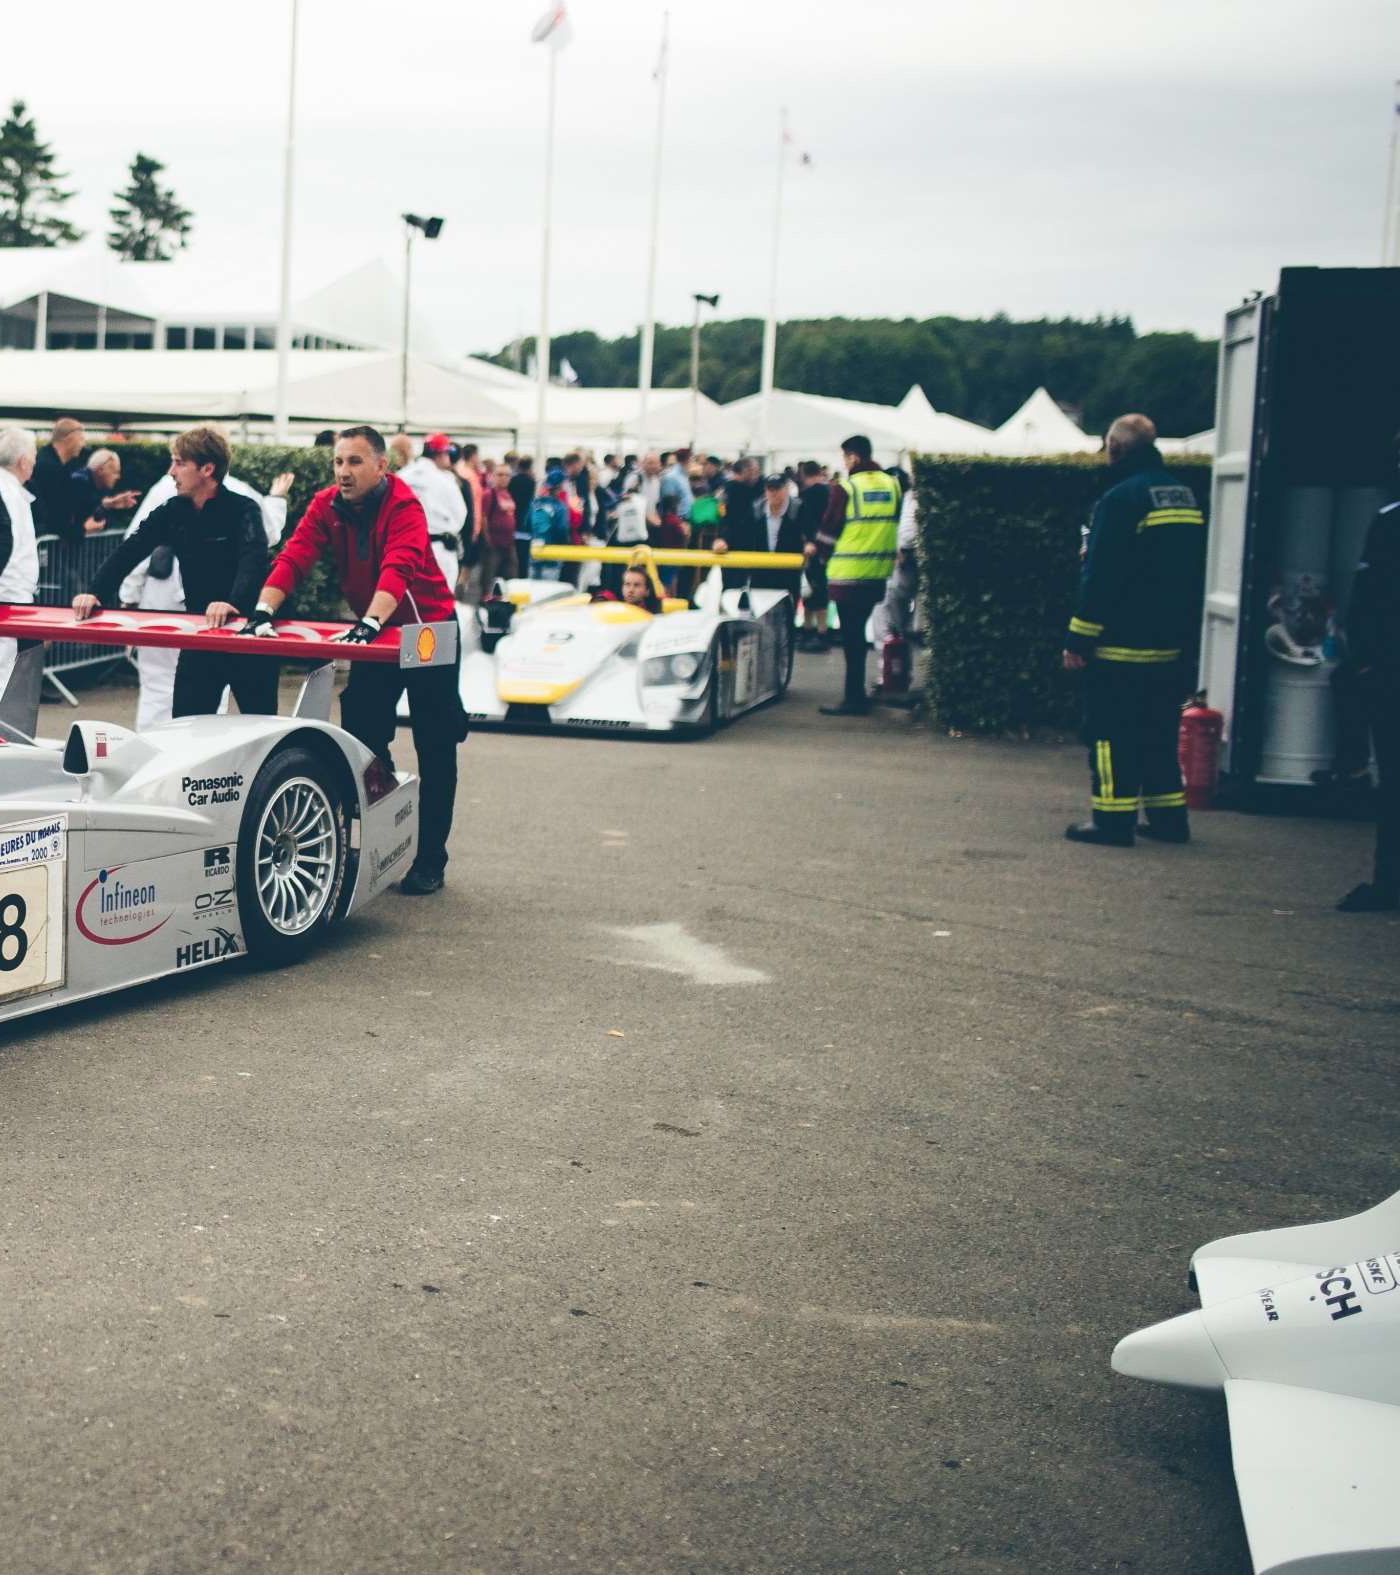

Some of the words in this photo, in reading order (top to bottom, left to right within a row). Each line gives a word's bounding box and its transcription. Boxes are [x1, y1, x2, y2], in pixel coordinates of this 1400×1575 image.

[567, 717, 631, 729] MICHELIN
[181, 771, 244, 793] Panasonic
[188, 792, 208, 806] Car
[211, 788, 240, 804] Audio
[25, 830, 37, 846] DU
[31, 847, 48, 861] 2000
[204, 846, 231, 868] R
[205, 865, 230, 878] RICARDO
[101, 880, 155, 913] Infineon
[176, 926, 240, 968] HELIX
